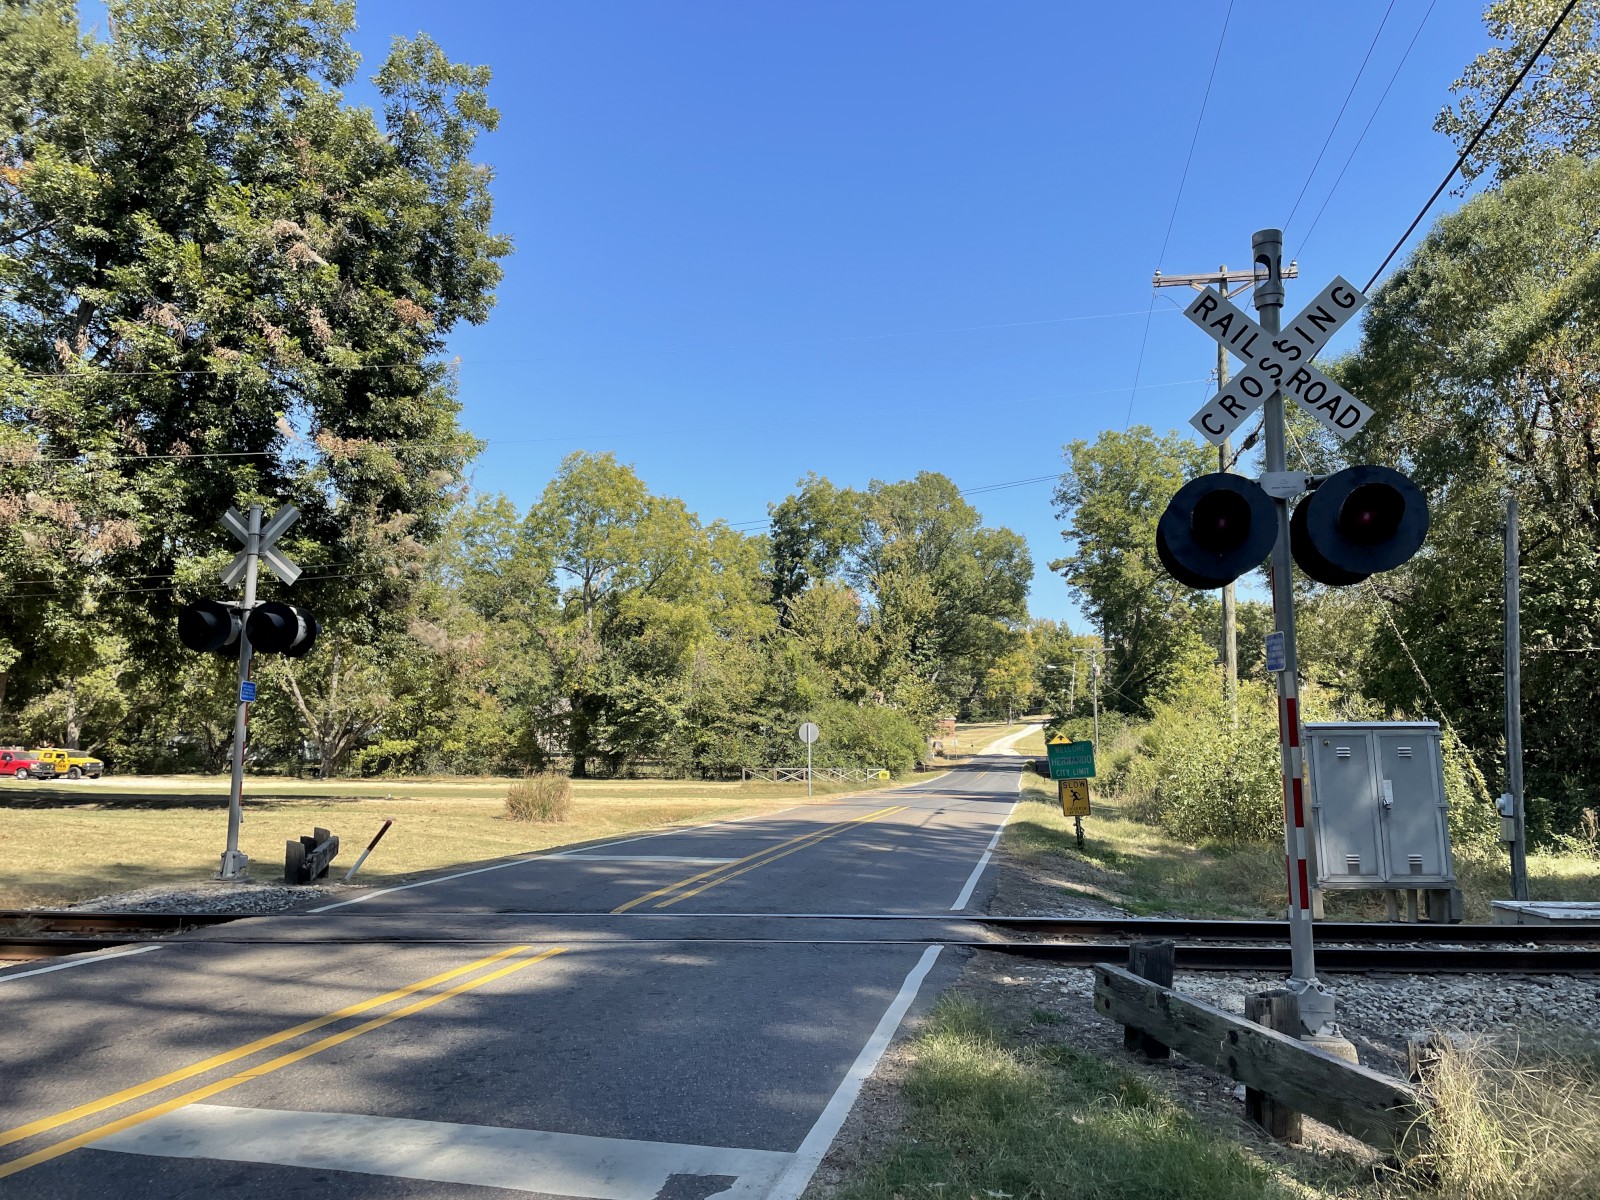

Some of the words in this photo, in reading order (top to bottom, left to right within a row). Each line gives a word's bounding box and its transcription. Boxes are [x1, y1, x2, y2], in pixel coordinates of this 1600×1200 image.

[1201, 286, 1356, 435] CROSSING
[1056, 769, 1070, 777] CITY
[1072, 768, 1089, 776] LIMIT
